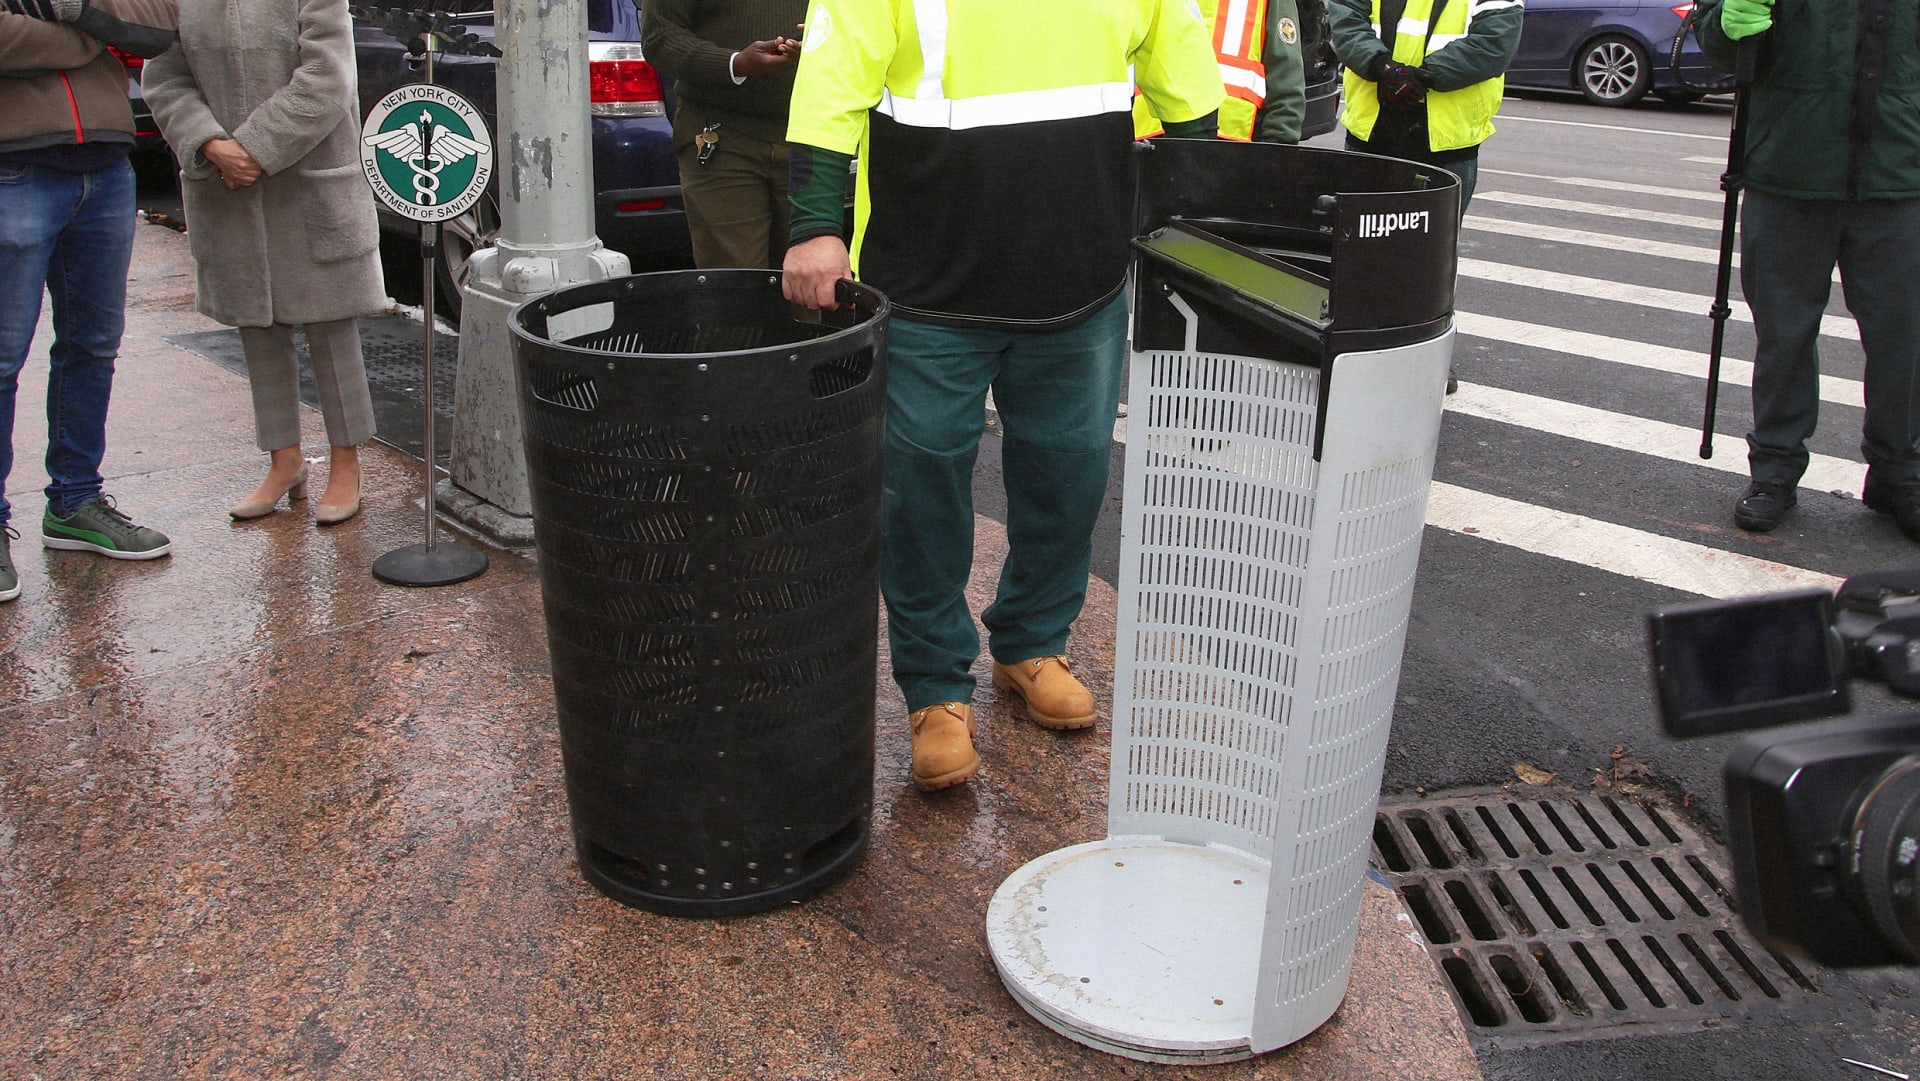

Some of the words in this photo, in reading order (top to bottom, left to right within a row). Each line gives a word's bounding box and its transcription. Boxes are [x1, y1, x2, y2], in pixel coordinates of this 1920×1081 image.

[382, 90, 407, 111] NEW
[410, 88, 445, 101] YORK
[447, 96, 473, 117] CITY
[364, 159, 418, 218] DEPARTMENT
[420, 209, 433, 219] OF
[437, 167, 488, 218] SANITATION
[1359, 210, 1429, 238] Landfill
